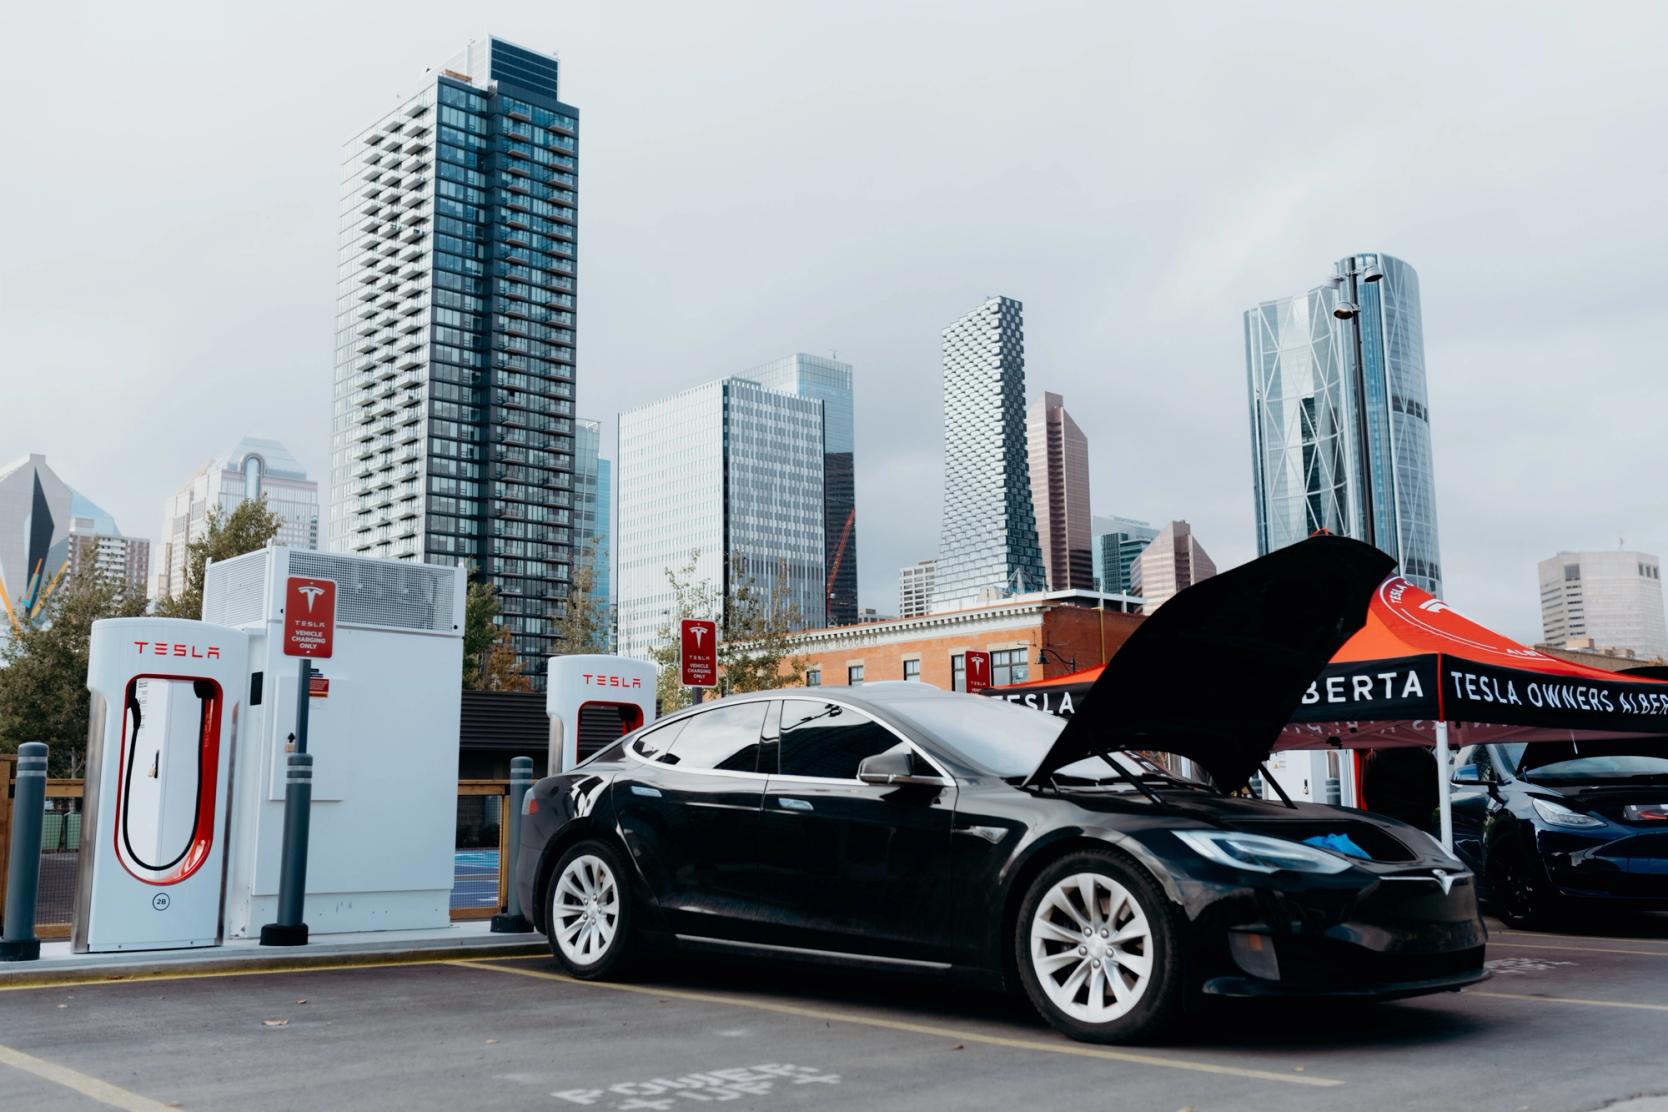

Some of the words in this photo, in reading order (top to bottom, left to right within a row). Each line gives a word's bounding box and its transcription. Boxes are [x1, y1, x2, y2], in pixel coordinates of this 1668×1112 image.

[294, 620, 326, 628] TESLA
[291, 635, 327, 644] CHARGING
[133, 641, 221, 660] TESLA
[582, 673, 641, 689] TESLA
[1451, 671, 1523, 706] TESLA
[1527, 682, 1615, 713] OWNERS
[990, 691, 1076, 715] SLA
